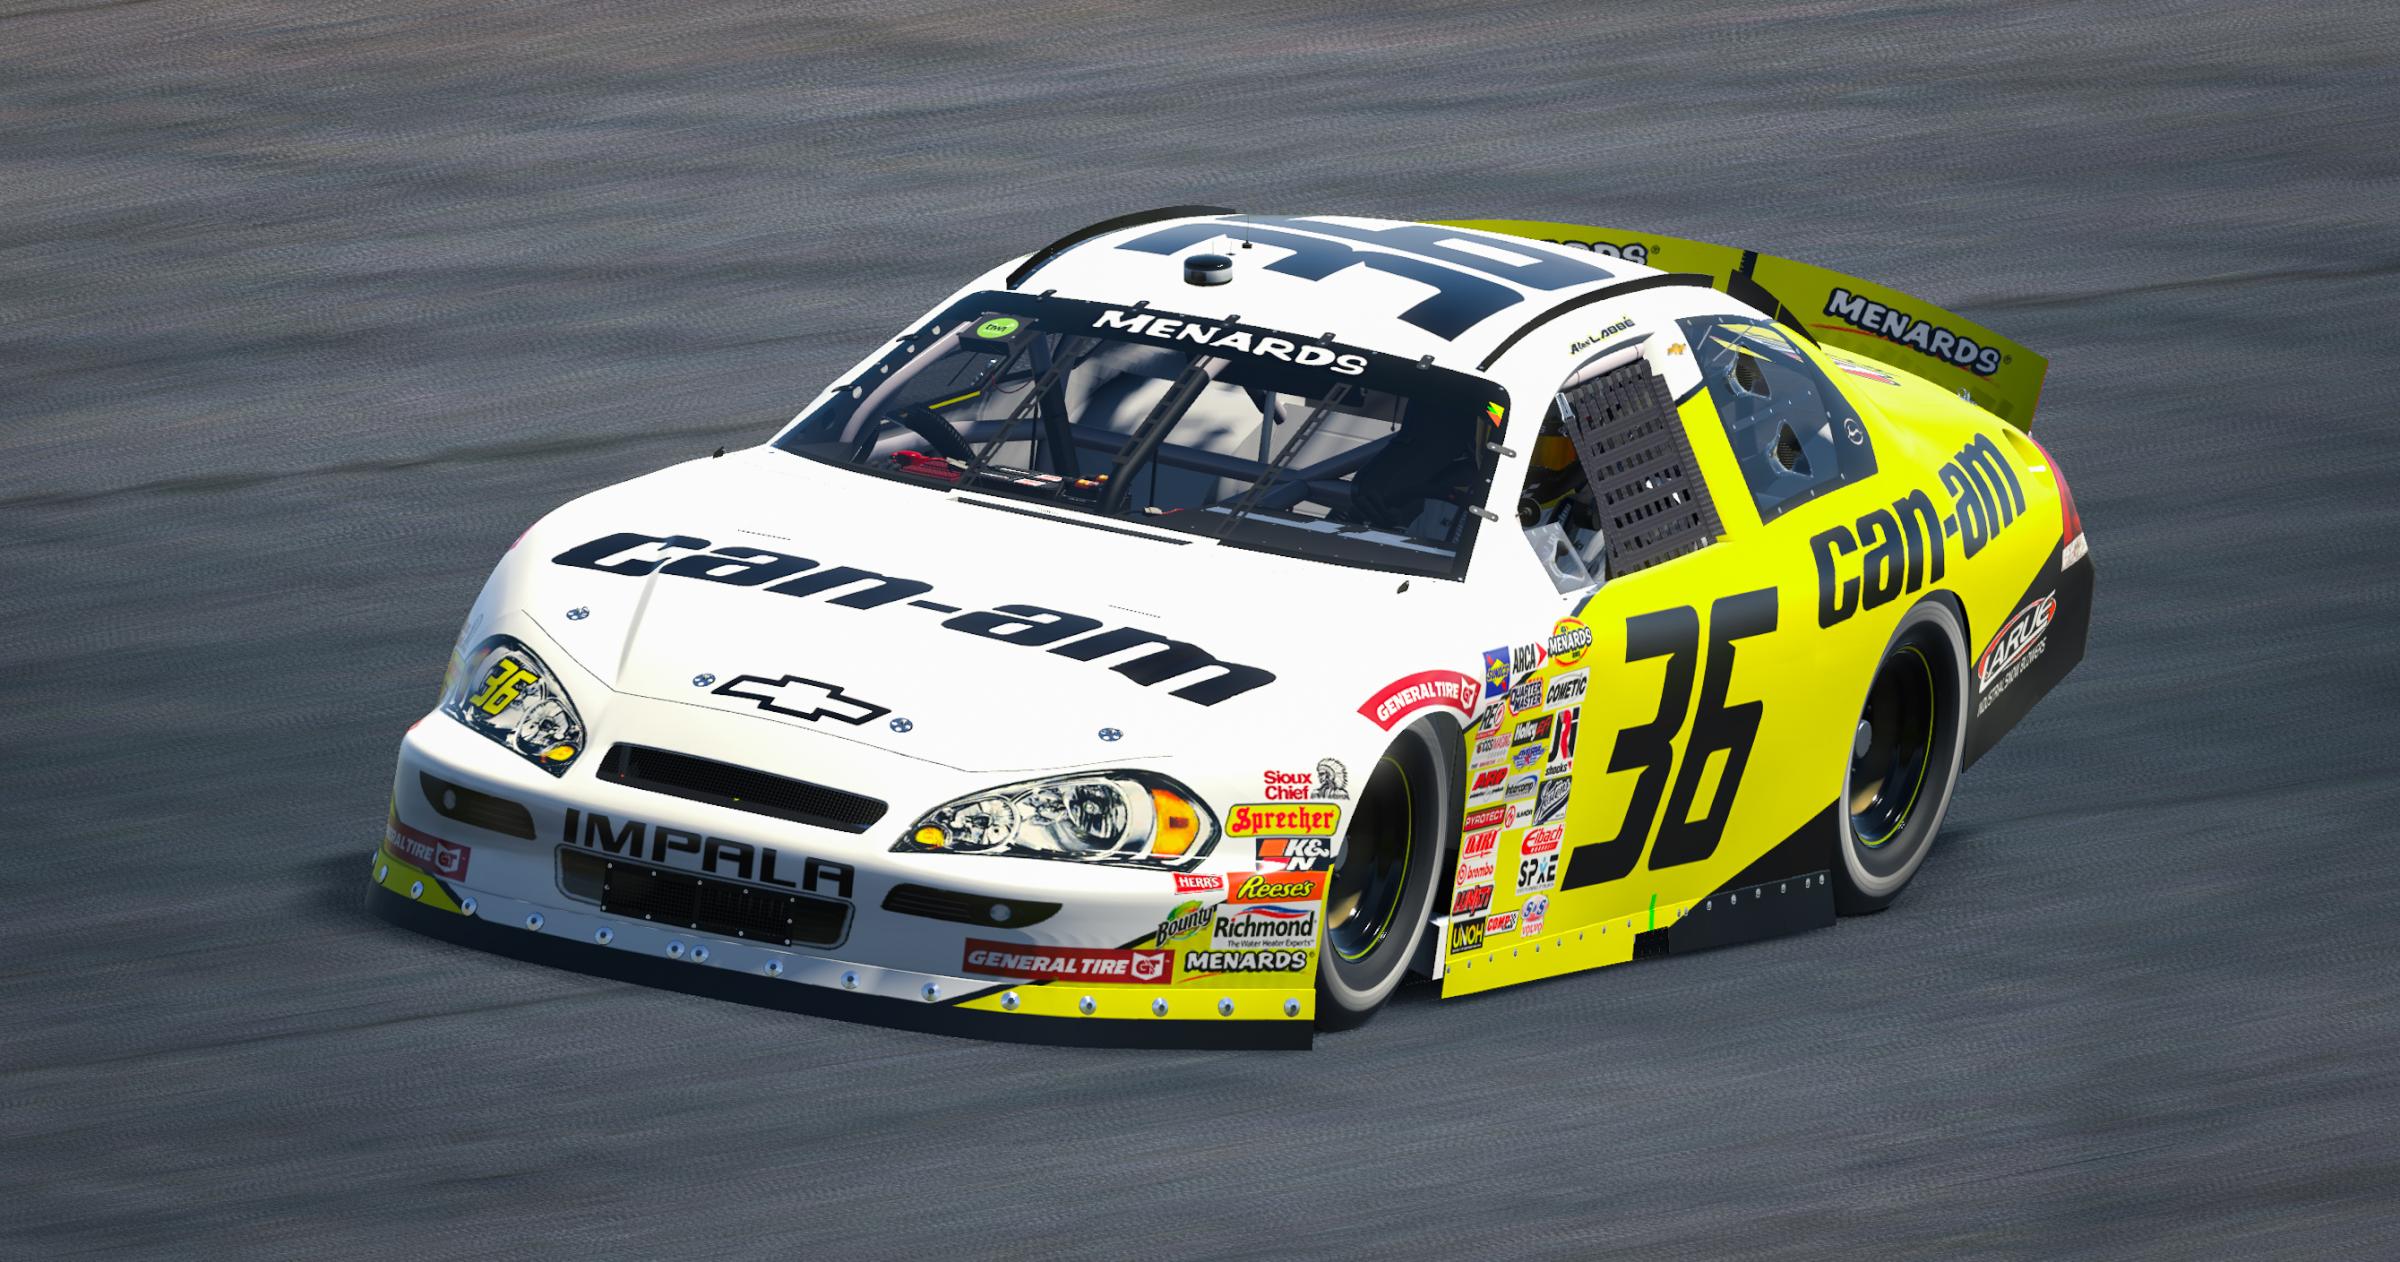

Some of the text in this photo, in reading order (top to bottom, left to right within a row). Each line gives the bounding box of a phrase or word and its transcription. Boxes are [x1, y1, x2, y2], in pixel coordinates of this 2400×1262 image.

[1093, 309, 1368, 378] MENARDS
[1824, 288, 2001, 376] MENARDS
[1809, 432, 2027, 630] can-am
[551, 531, 1277, 707] can-am
[1548, 626, 1592, 657] MENARDS
[1512, 643, 1536, 675] ARCA
[469, 657, 539, 717] 36
[1510, 681, 1542, 706] QUARTER
[1546, 676, 1588, 704] COMETIC
[1376, 680, 1460, 722] GENERAL TIRE
[1513, 693, 1542, 712] MASTER
[1515, 720, 1539, 742] Holley
[1560, 586, 1778, 891] 36
[1264, 770, 1312, 785] Sioux
[1471, 767, 1509, 792] ARP
[1545, 763, 1568, 777] shocks
[1265, 785, 1311, 801] Chief
[1231, 806, 1334, 834] Sprecher
[1466, 809, 1505, 827] PYROTECT
[405, 837, 435, 862] TIRE
[1521, 824, 1565, 855] Eibach
[563, 807, 856, 899] IMPALA
[1178, 876, 1221, 888] HERR'S
[1467, 862, 1494, 880] brembo
[1237, 875, 1316, 899] Reese's
[1156, 907, 1213, 948] Bounty
[1214, 910, 1313, 938] Richmond
[1453, 922, 1485, 948] UNOH
[1240, 939, 1260, 948] Water
[1262, 939, 1285, 948] Heater
[967, 949, 1131, 975] GENERAL TIRE
[1184, 950, 1308, 973] MENARDS
